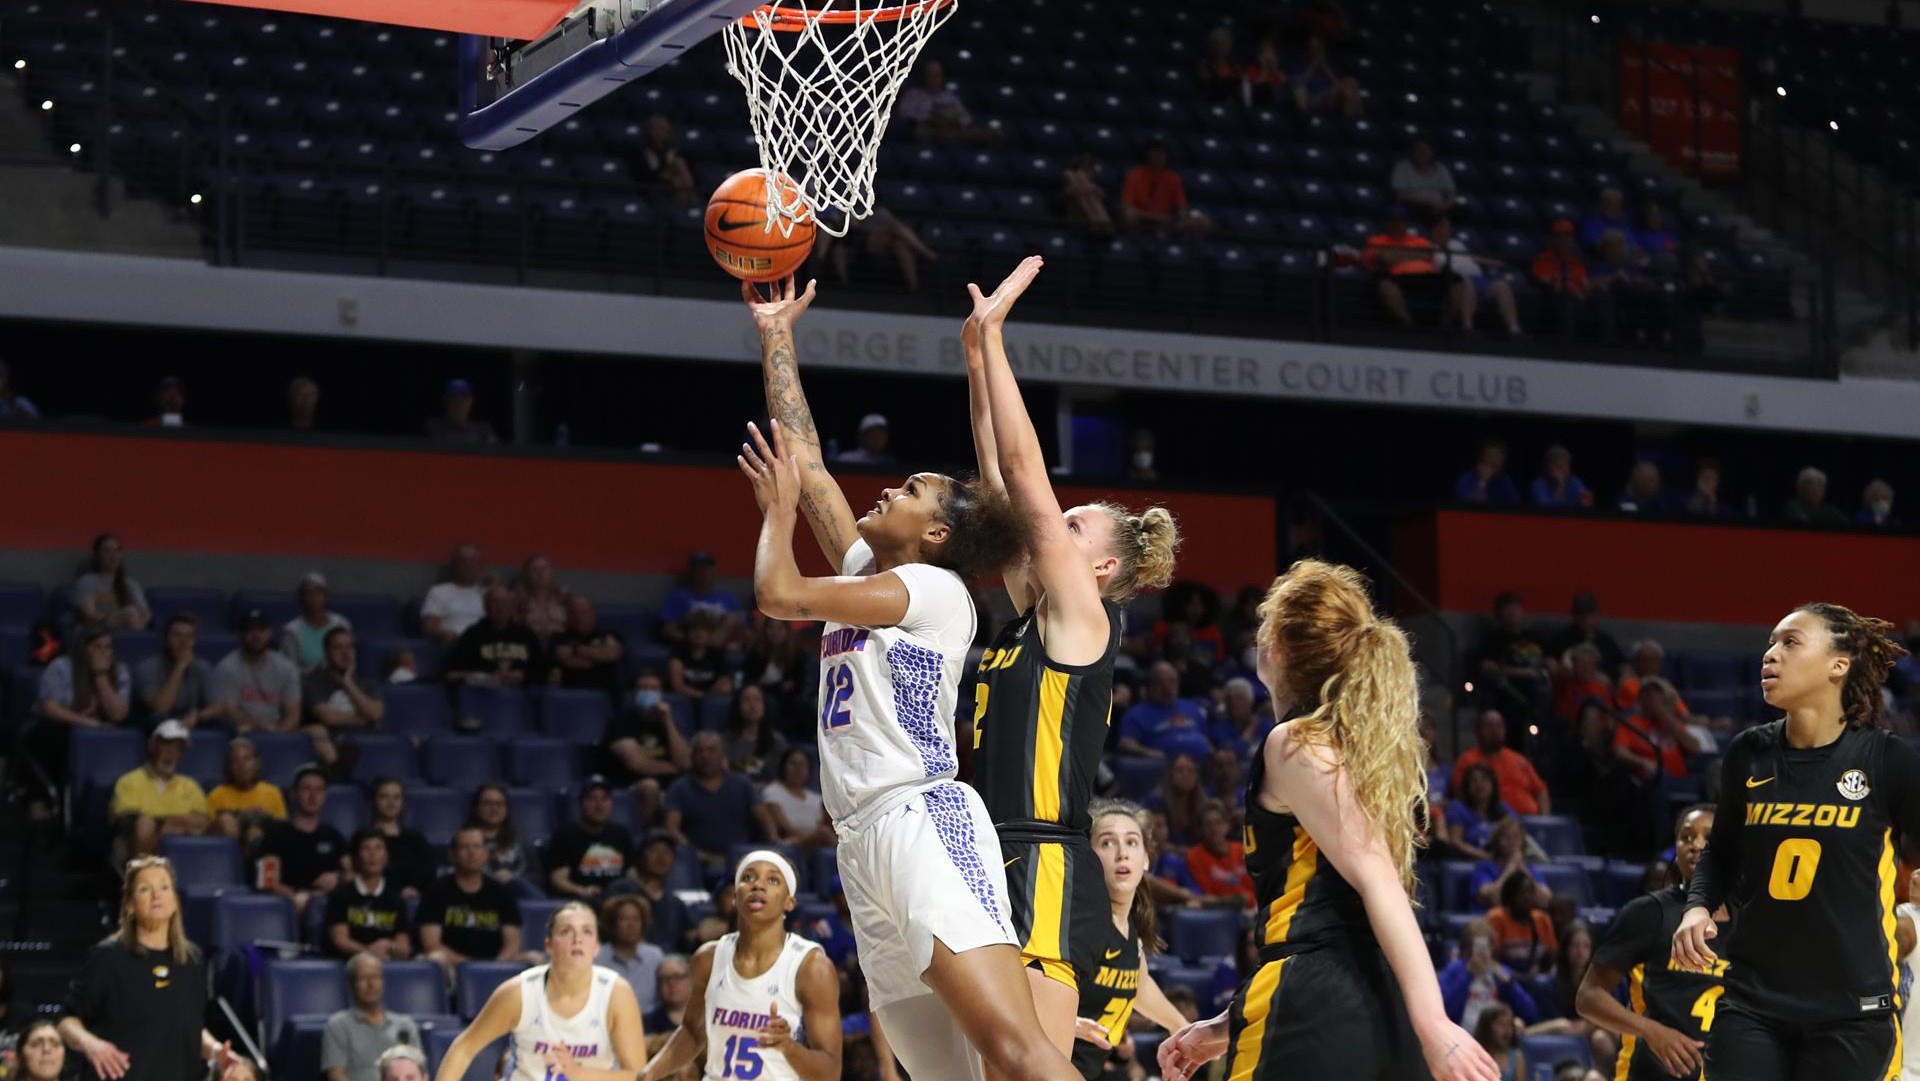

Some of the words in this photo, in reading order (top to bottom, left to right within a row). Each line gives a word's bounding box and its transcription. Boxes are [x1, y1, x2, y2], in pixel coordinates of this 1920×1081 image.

[743, 328, 918, 365] GORGE
[939, 336, 1083, 374] BAND
[1103, 348, 1259, 387] CENTER
[1278, 360, 1411, 395] COURT
[1429, 371, 1528, 402] CLUB
[822, 663, 854, 730] 12
[1744, 802, 1861, 828] MIZZOU
[1768, 838, 1822, 901] 0
[713, 1006, 781, 1030] FLORID
[1690, 985, 1725, 1032] 4
[722, 1035, 763, 1080] 15
